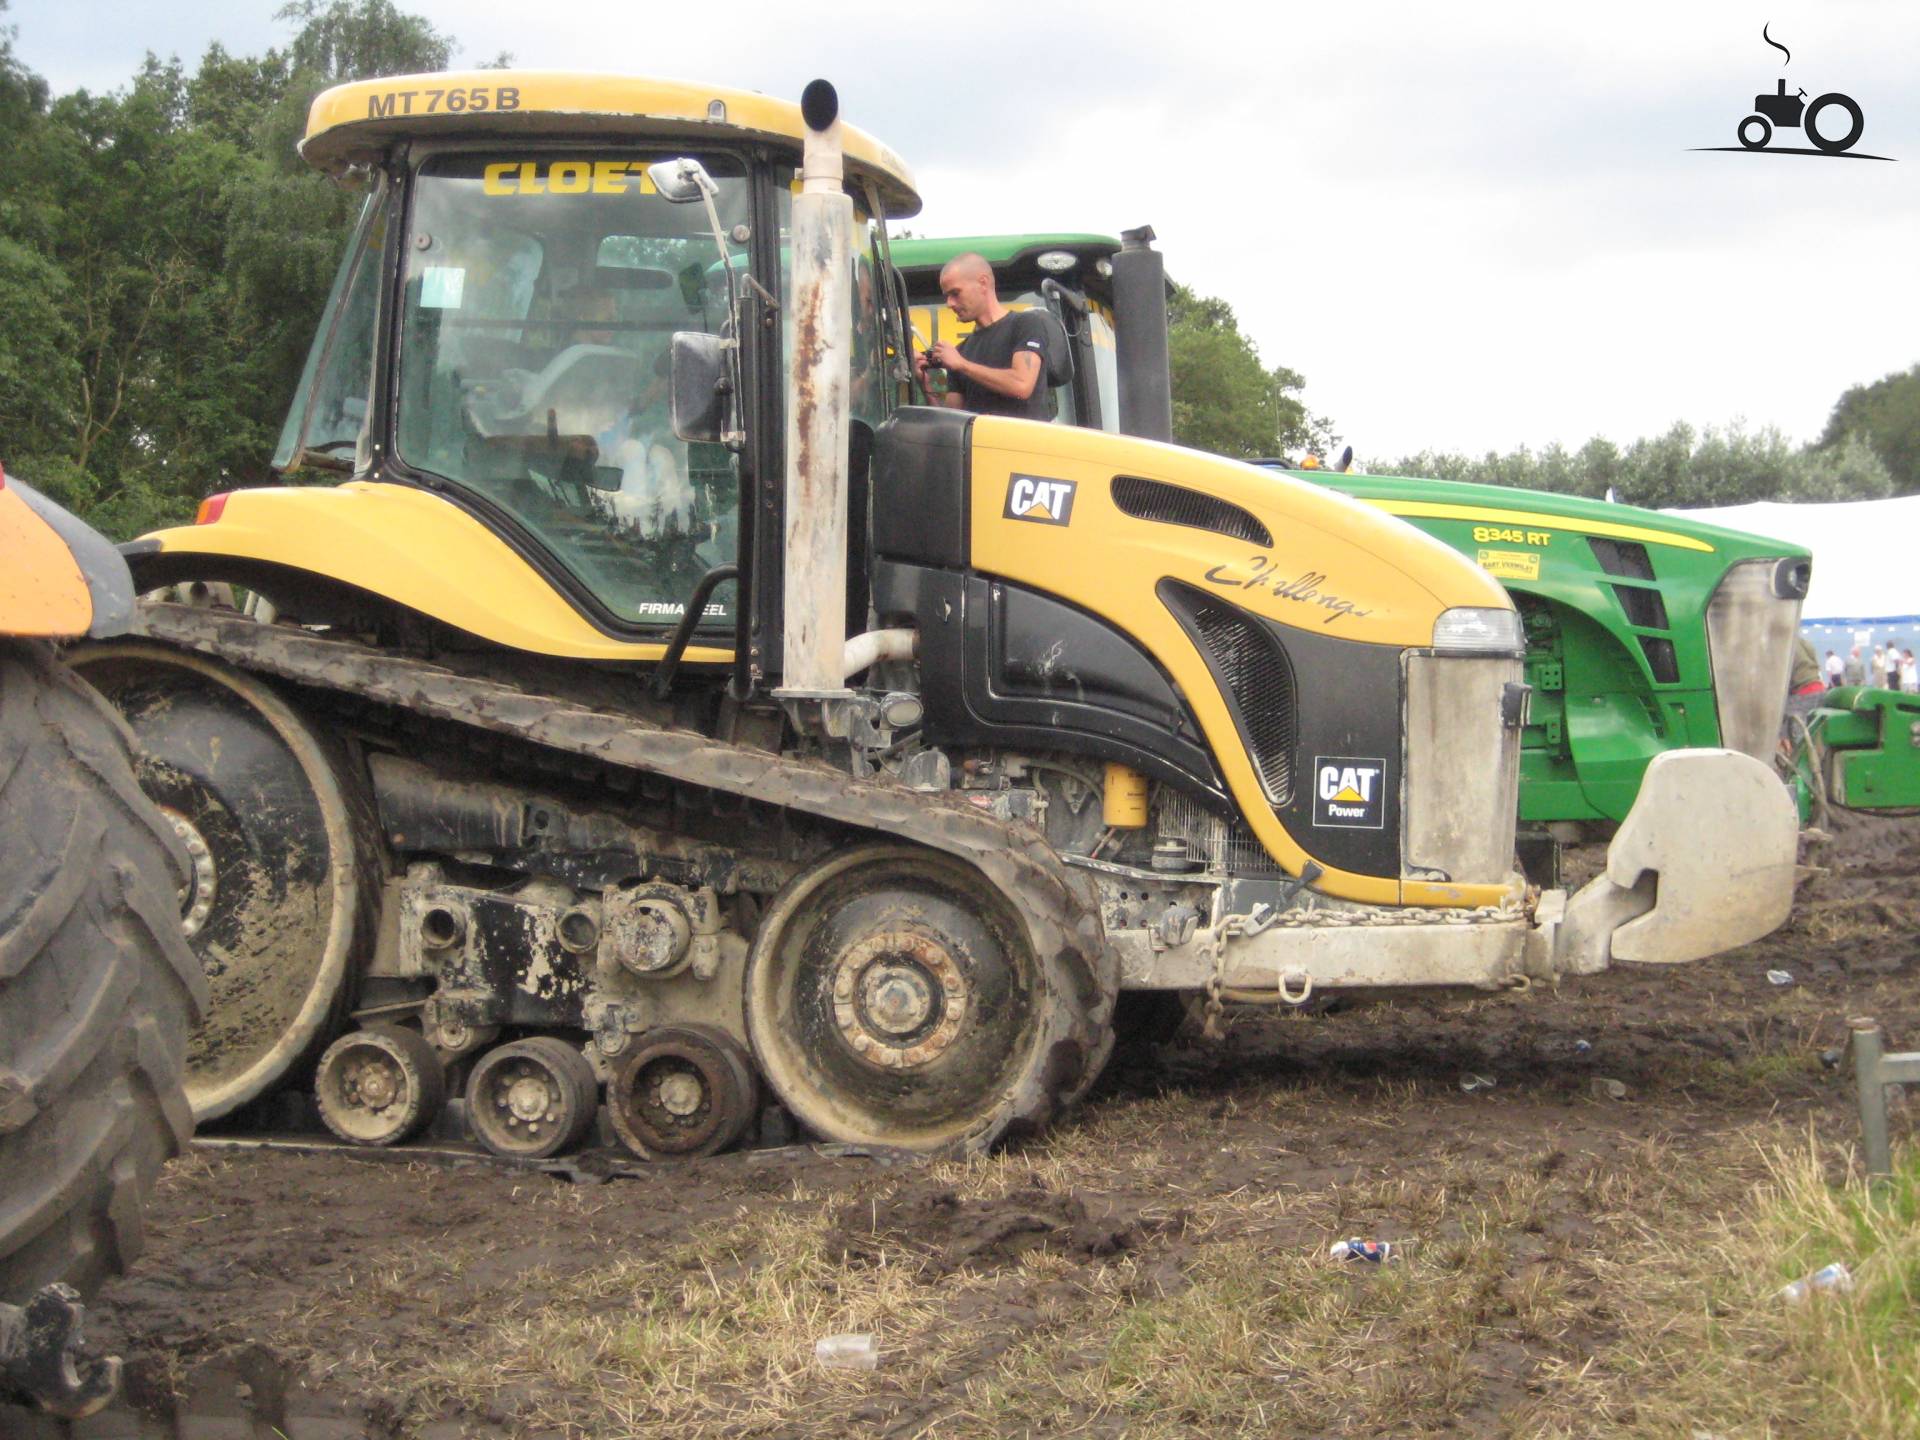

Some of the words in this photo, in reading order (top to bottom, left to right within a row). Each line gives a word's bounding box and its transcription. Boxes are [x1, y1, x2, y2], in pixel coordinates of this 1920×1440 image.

[368, 91, 418, 120] MT
[425, 88, 489, 112] 765
[495, 87, 520, 110] B
[1011, 478, 1071, 520] CAT
[1473, 526, 1524, 543] 8345
[1527, 531, 1551, 546] RT
[639, 602, 685, 615] FIRMA
[1320, 766, 1376, 802] CAT
[1328, 803, 1366, 818] Power
